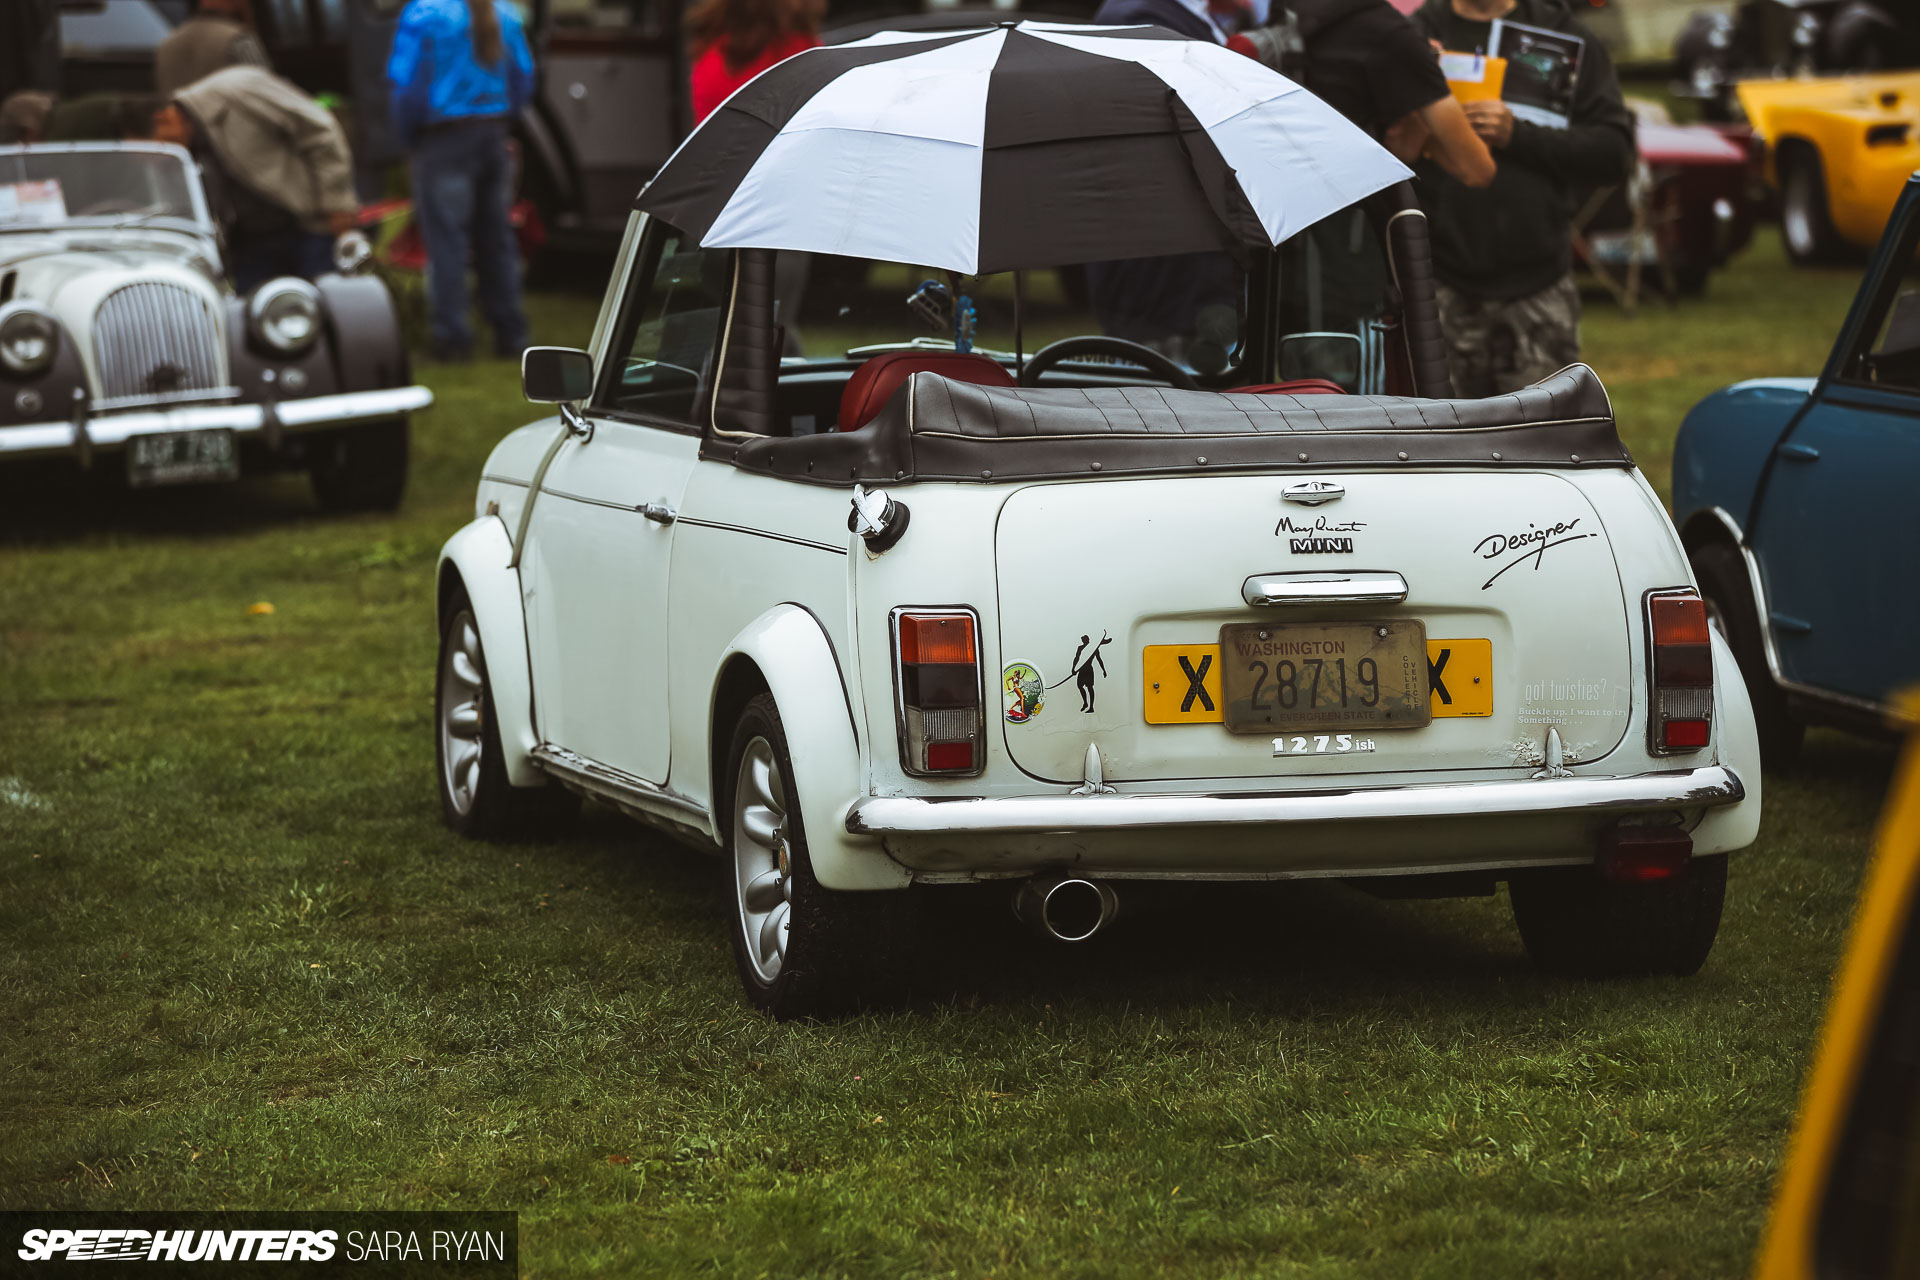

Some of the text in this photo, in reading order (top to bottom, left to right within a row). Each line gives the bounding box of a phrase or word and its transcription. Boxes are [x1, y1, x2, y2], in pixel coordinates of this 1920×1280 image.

[1290, 538, 1353, 554] MINI
[1473, 518, 1580, 570] Designer
[1238, 641, 1345, 656] WASHINGTON
[1178, 654, 1215, 712] X
[1248, 657, 1380, 711] 28719
[1525, 680, 1545, 705] got
[1280, 711, 1375, 722] EVERGREEN STATE
[1519, 708, 1550, 716] Buckle
